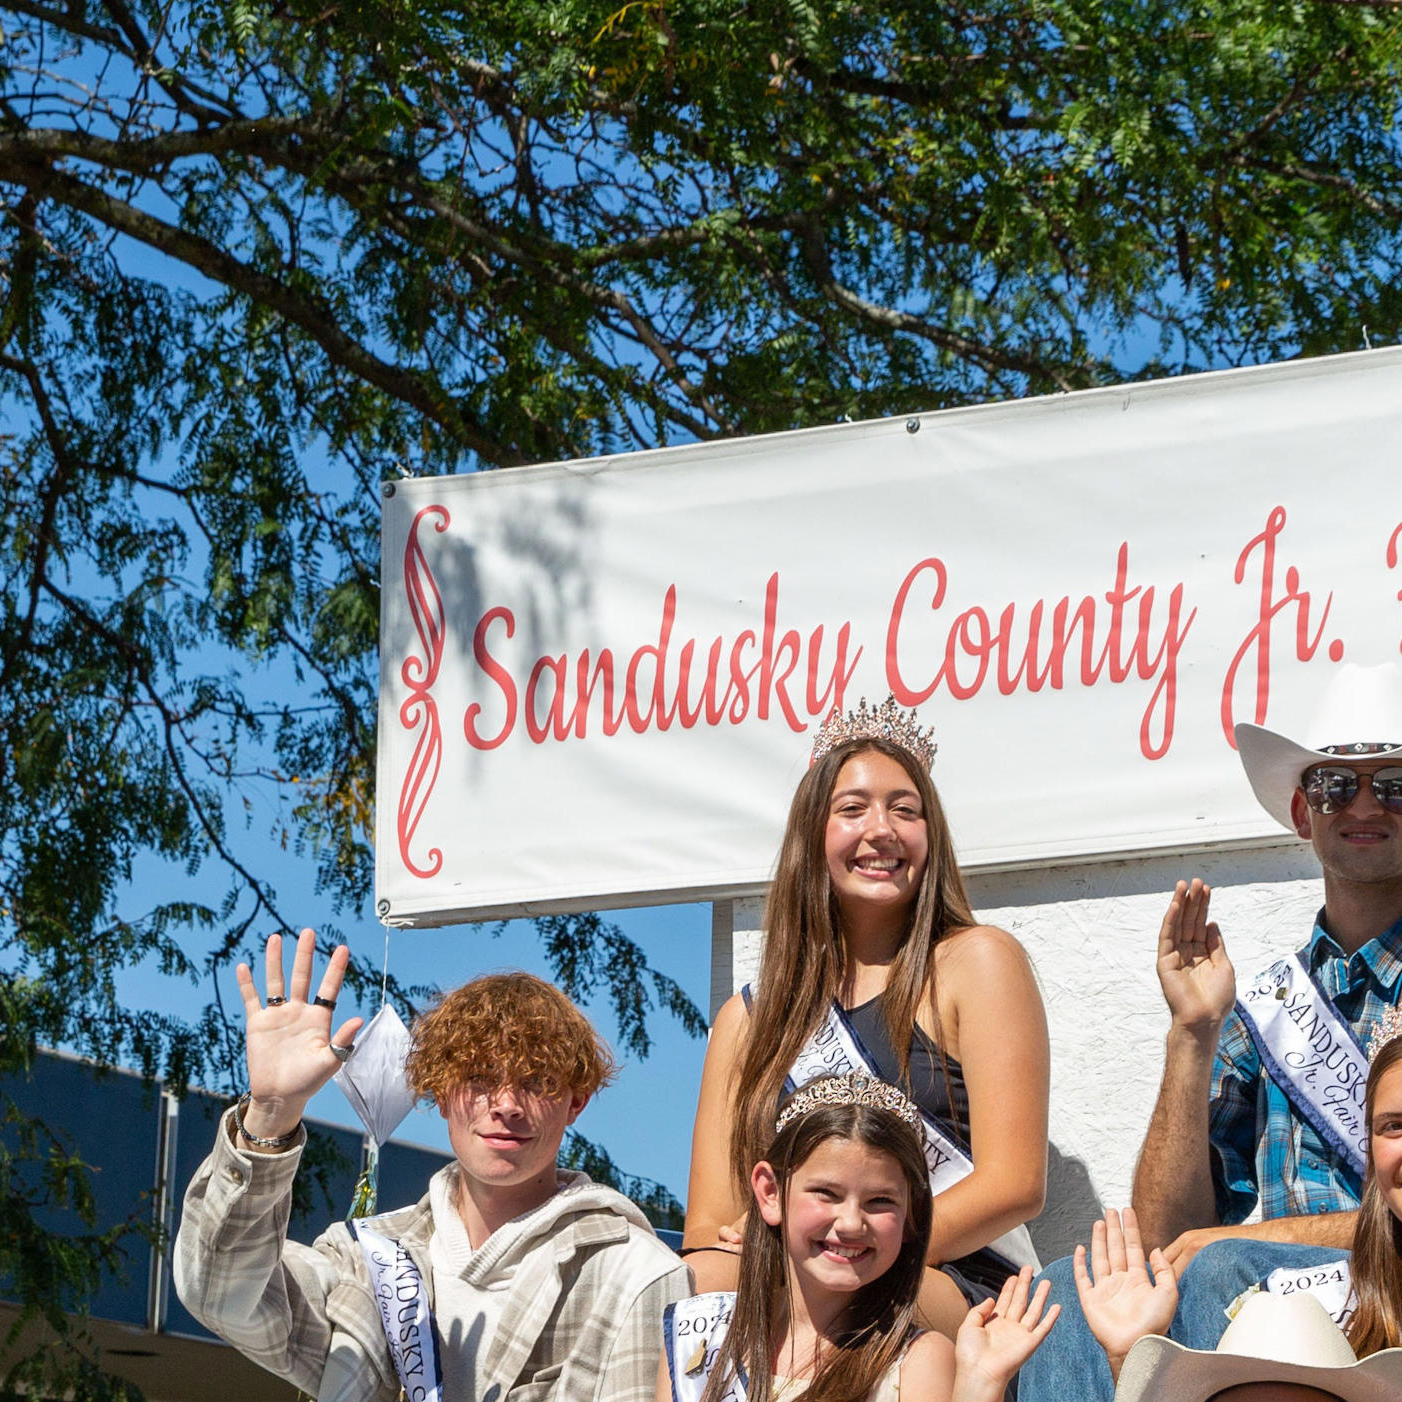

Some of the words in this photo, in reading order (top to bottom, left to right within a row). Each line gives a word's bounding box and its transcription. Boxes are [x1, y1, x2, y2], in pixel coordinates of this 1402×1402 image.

[464, 571, 864, 760] Sandusky
[886, 541, 1198, 760] County
[1221, 505, 1344, 750] Jr.
[1284, 1051, 1325, 1090] Jr.
[1322, 1085, 1359, 1137] Fair
[395, 1241, 425, 1381] ANDUSKY
[1280, 1269, 1344, 1296] 2024
